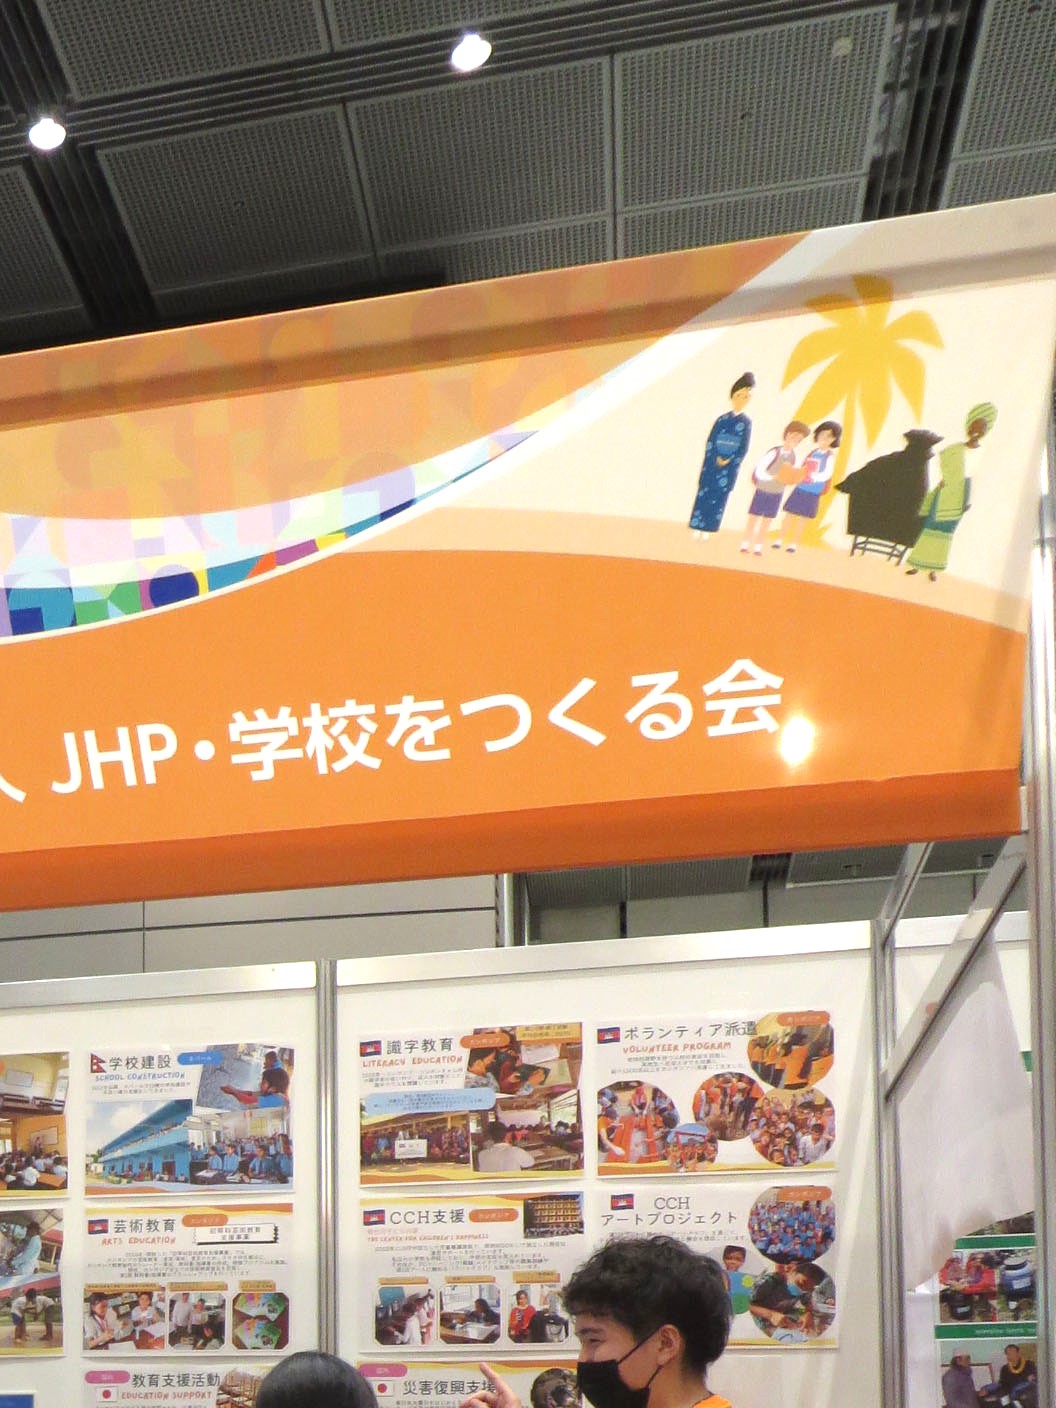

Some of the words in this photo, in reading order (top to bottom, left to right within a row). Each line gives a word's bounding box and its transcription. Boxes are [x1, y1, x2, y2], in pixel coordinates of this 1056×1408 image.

[50, 658, 785, 794] JHP・学校をつくる会
[386, 1037, 454, 1055] 識字教育
[623, 1044, 679, 1054] VOLUNTEER
[683, 1042, 732, 1051] PROGRAM
[109, 1054, 172, 1071] 学校建設
[412, 1056, 463, 1065] EDUCATION
[654, 1197, 691, 1210] CCH
[390, 1209, 465, 1224] CCH支援
[113, 1219, 176, 1234] 芸術教育
[128, 1235, 176, 1244] EDUCATION
[132, 1373, 221, 1388] 教育支援活動
[121, 1392, 169, 1401] EDUCATION
[173, 1391, 212, 1400] SUPPORT
